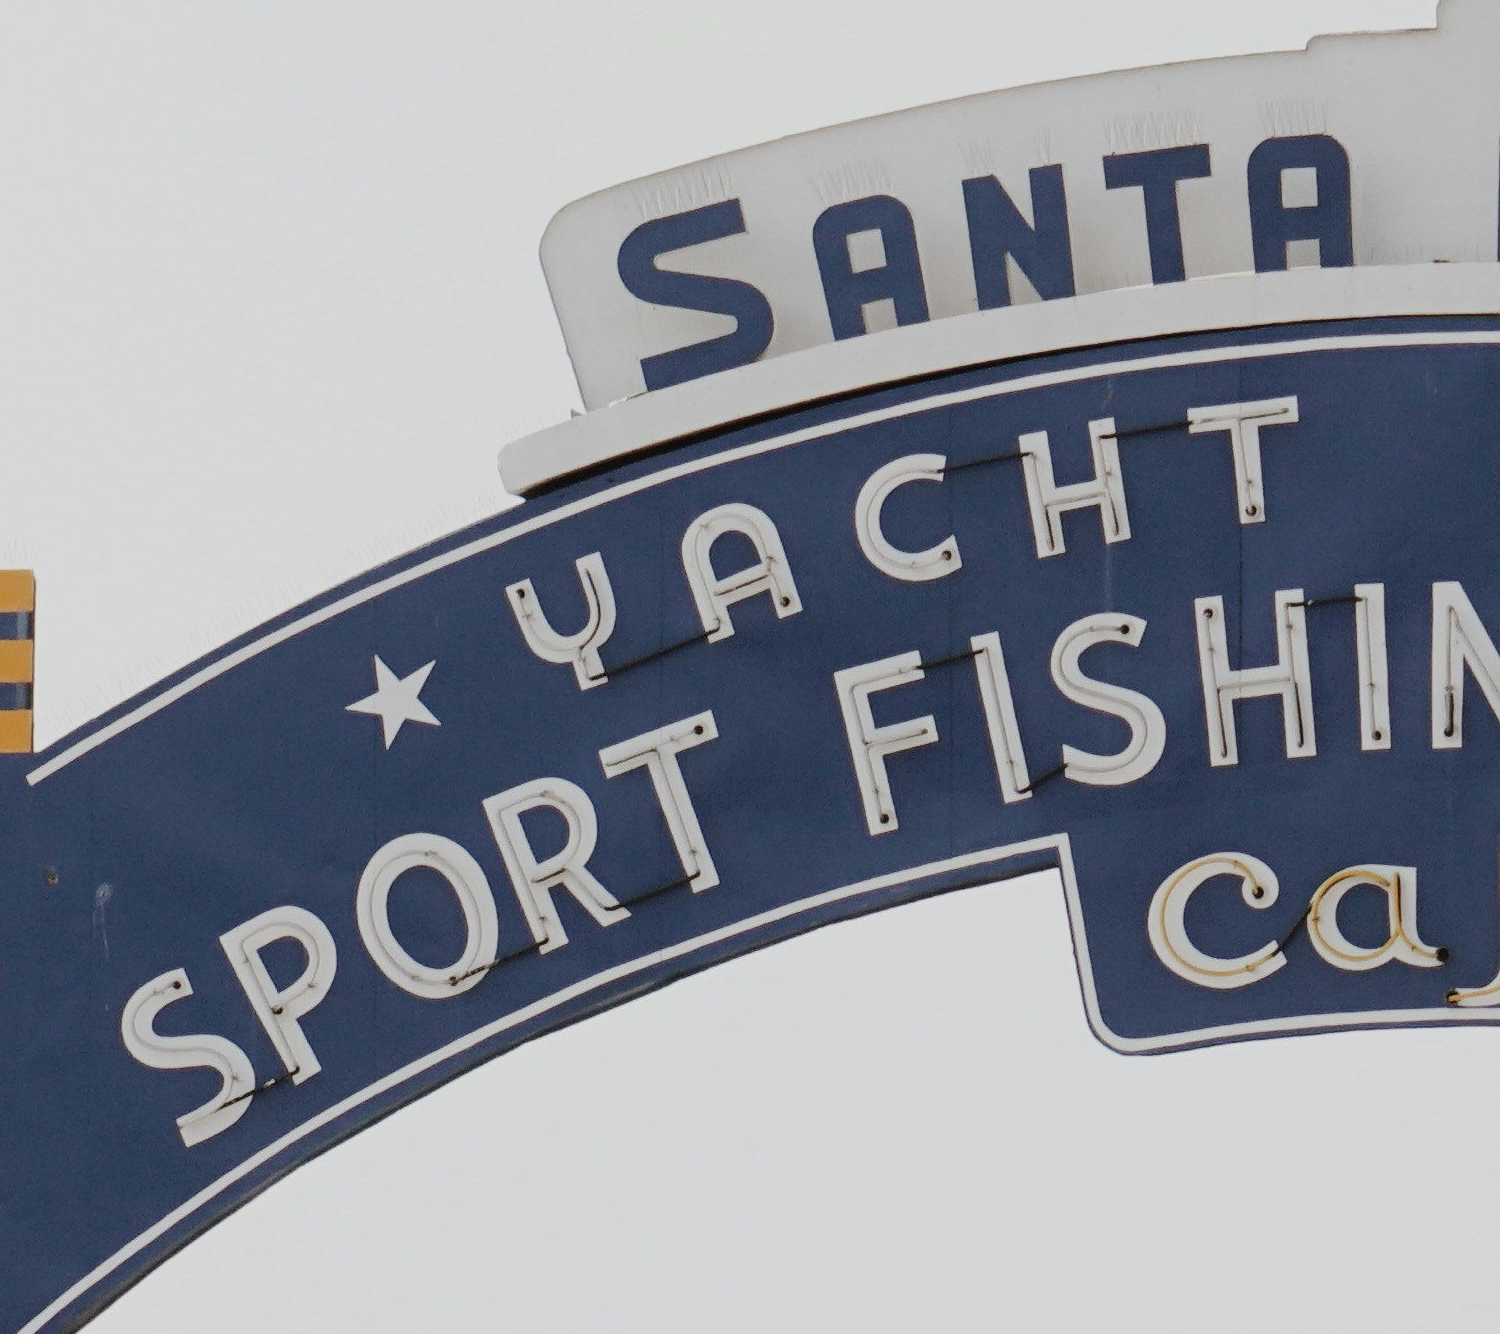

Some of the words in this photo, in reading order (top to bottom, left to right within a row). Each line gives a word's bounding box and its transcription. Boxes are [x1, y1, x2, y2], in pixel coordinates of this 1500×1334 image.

[616, 133, 1353, 392] SANTA
[506, 395, 1300, 693] YACHT
[120, 709, 720, 1148] SPORT
